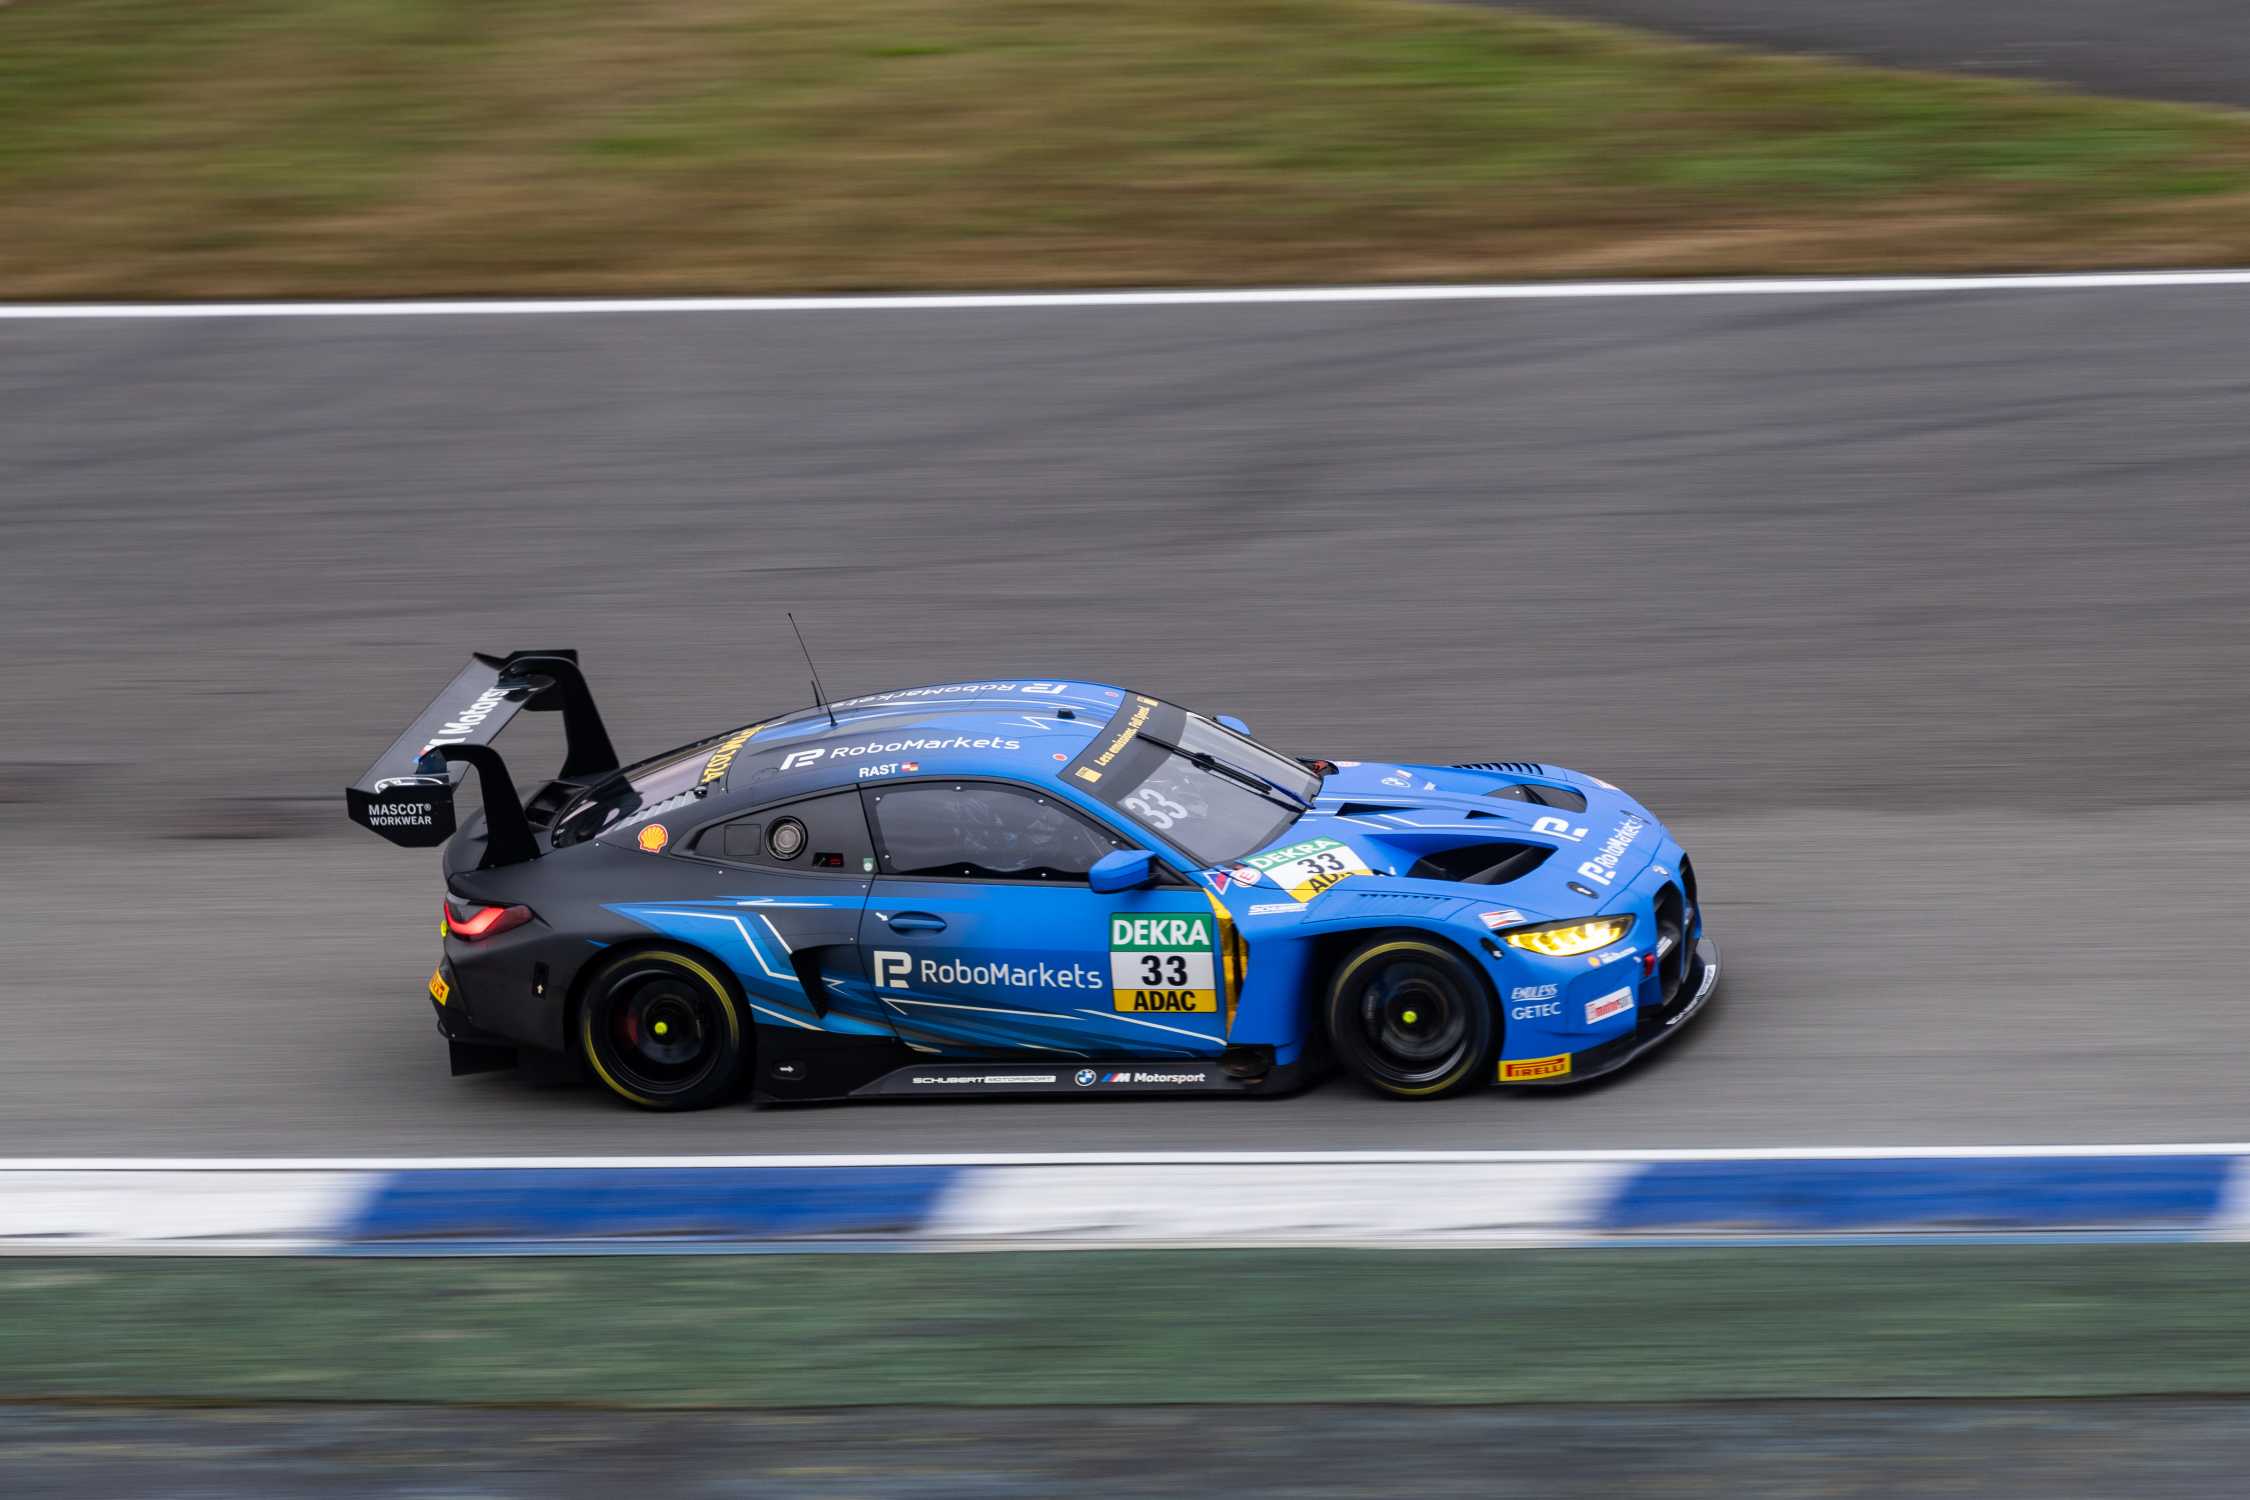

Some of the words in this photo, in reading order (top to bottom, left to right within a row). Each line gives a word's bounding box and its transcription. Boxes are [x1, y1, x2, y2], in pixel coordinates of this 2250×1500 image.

[438, 686, 510, 735] Motors
[830, 736, 1021, 759] RoboMarkets
[859, 763, 899, 778] RAST
[1124, 788, 1188, 830] 33
[370, 816, 432, 826] WORKWEAR
[1249, 838, 1342, 869] DEKRA
[1297, 852, 1345, 875] 33
[1113, 919, 1210, 945] DEKRA
[920, 958, 1103, 989] RoboMarkets
[1140, 955, 1188, 986] 33
[1133, 990, 1197, 1011] ADAC
[1511, 1002, 1562, 1020] GETEC
[1505, 1056, 1566, 1077] PIRELLI
[912, 1076, 984, 1084] SCHUBERT
[1133, 1072, 1205, 1085] Motorsport
